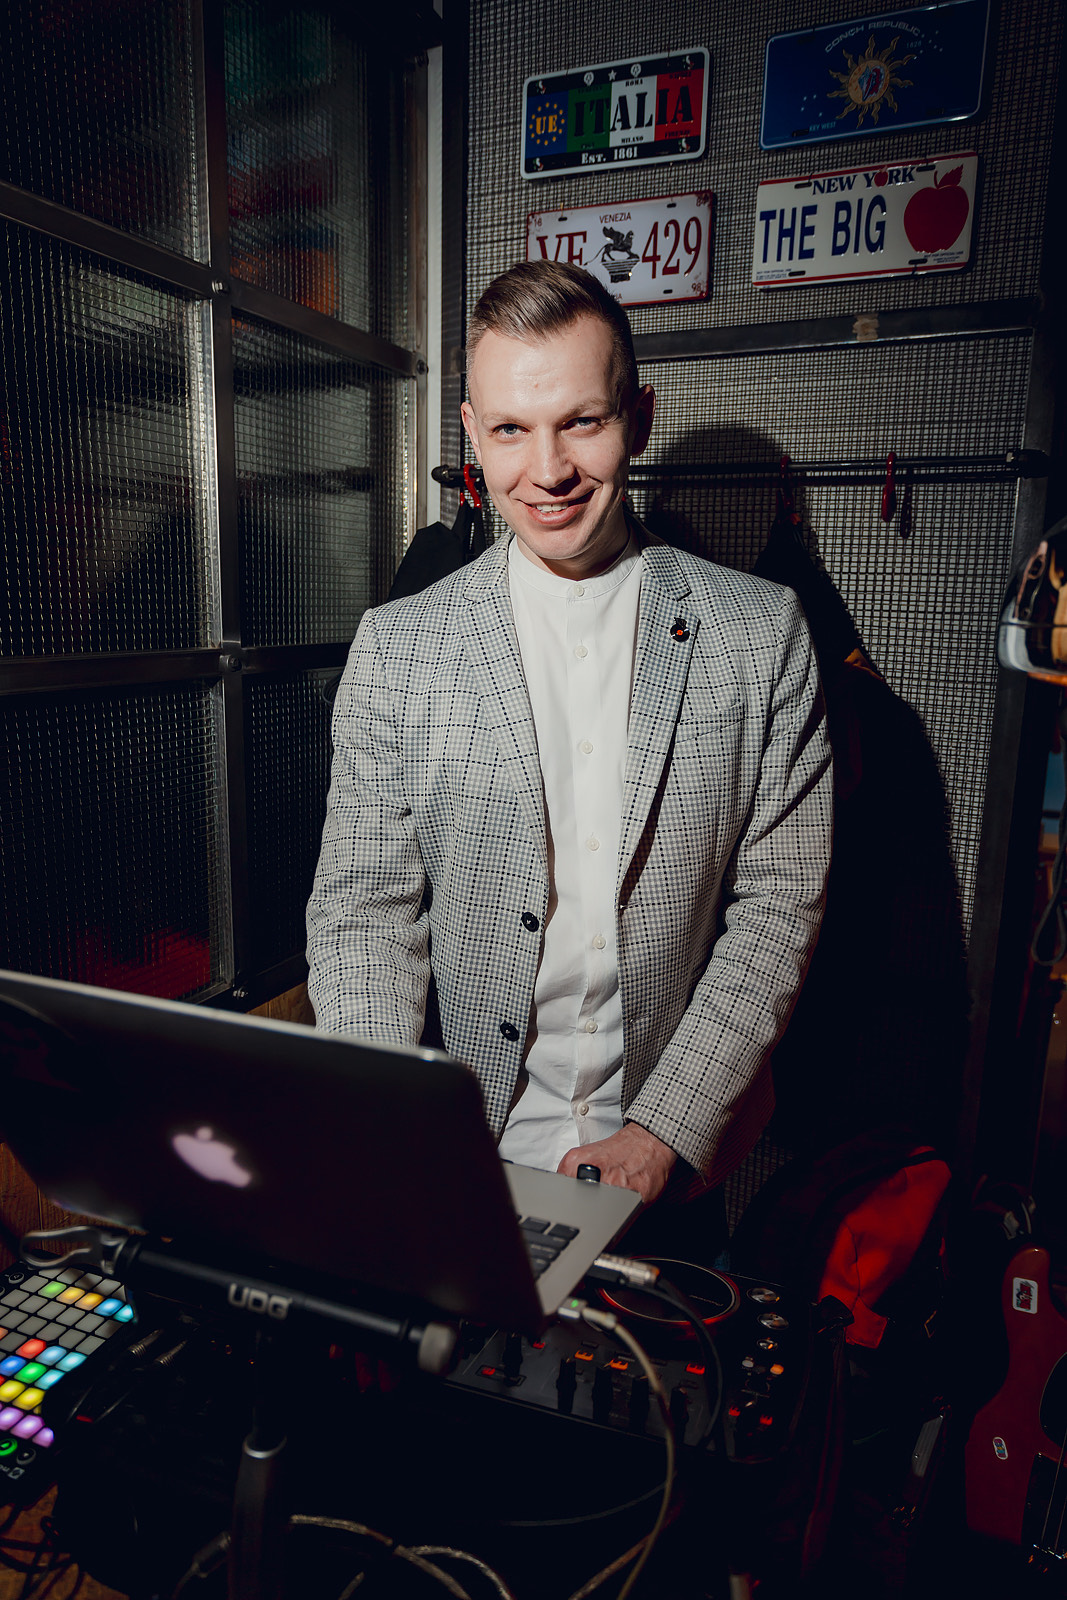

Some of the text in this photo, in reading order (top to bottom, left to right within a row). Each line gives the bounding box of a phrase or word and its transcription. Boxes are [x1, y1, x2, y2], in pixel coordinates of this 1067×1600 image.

[825, 20, 921, 53] CONCH REPUBLIC
[625, 79, 644, 87] ROMA
[574, 85, 694, 137] ITALIA
[536, 114, 558, 135] UE
[621, 136, 644, 144] MILANO
[613, 147, 638, 161] 1861
[812, 174, 858, 195] NEW
[599, 212, 632, 224] VENEZIA
[759, 194, 887, 263] THE BIG
[642, 216, 702, 279] 429
[228, 1282, 290, 1319] UDG
